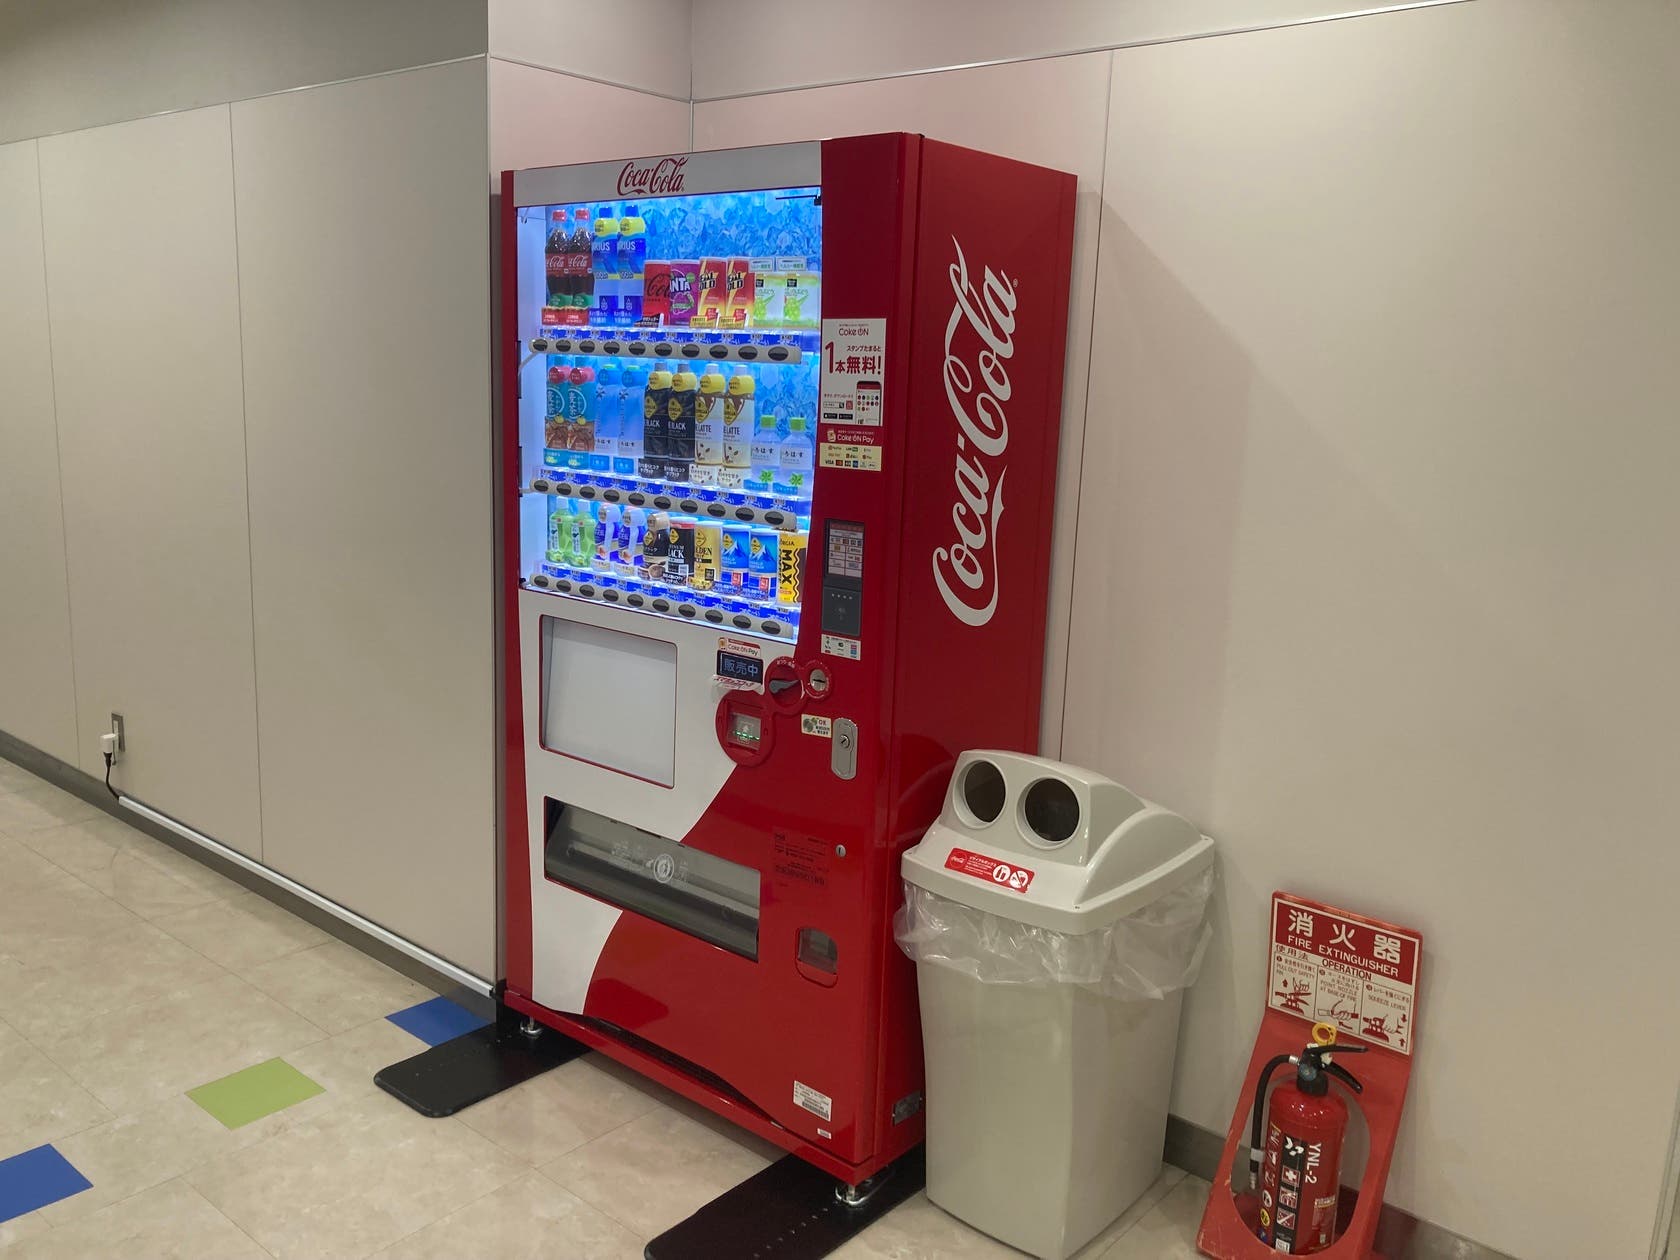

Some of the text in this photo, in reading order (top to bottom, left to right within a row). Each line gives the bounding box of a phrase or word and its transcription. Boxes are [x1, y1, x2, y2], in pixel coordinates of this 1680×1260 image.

[617, 157, 689, 196] Coca-Cola
[838, 327, 869, 336] Coke ON
[932, 234, 1018, 627] Coca-Cola
[782, 549, 793, 585] MAX
[724, 659, 759, 677] 販売中
[1288, 909, 1401, 964] 消火器
[1288, 935, 1399, 978] FIRE EXTINGUISHER
[1322, 958, 1372, 981] OPERATION
[1305, 1143, 1322, 1184] YNL-2
